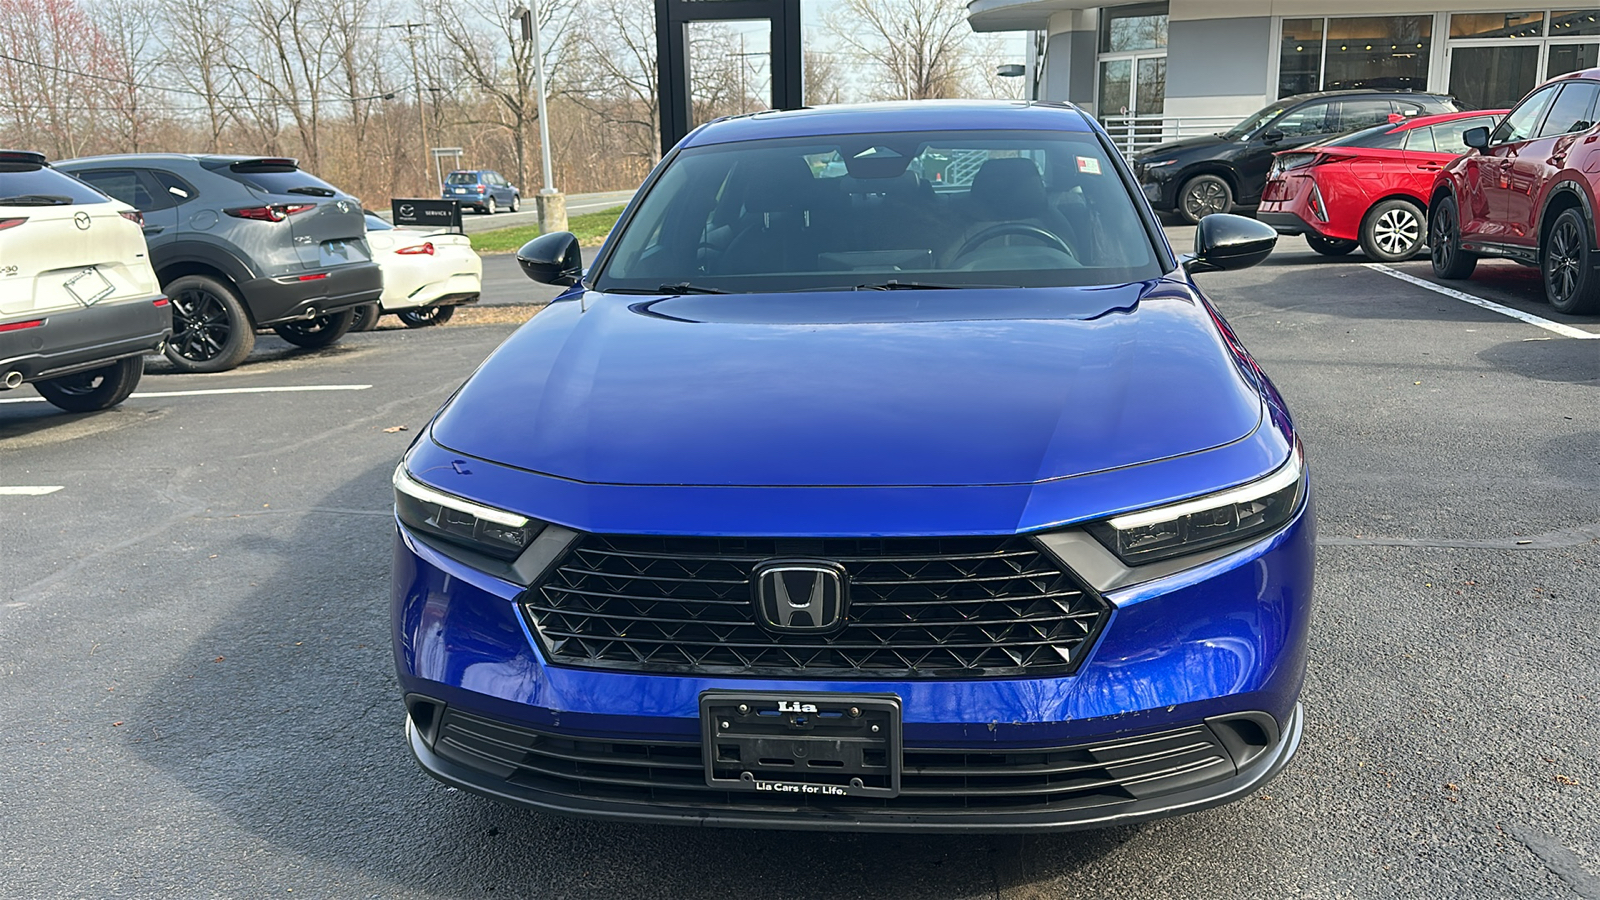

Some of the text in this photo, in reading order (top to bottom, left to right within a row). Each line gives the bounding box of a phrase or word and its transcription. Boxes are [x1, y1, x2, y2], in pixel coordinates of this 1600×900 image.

[0, 264, 19, 273] -30
[778, 701, 817, 713] Lia
[756, 782, 847, 795] Lia Cars for Life.
